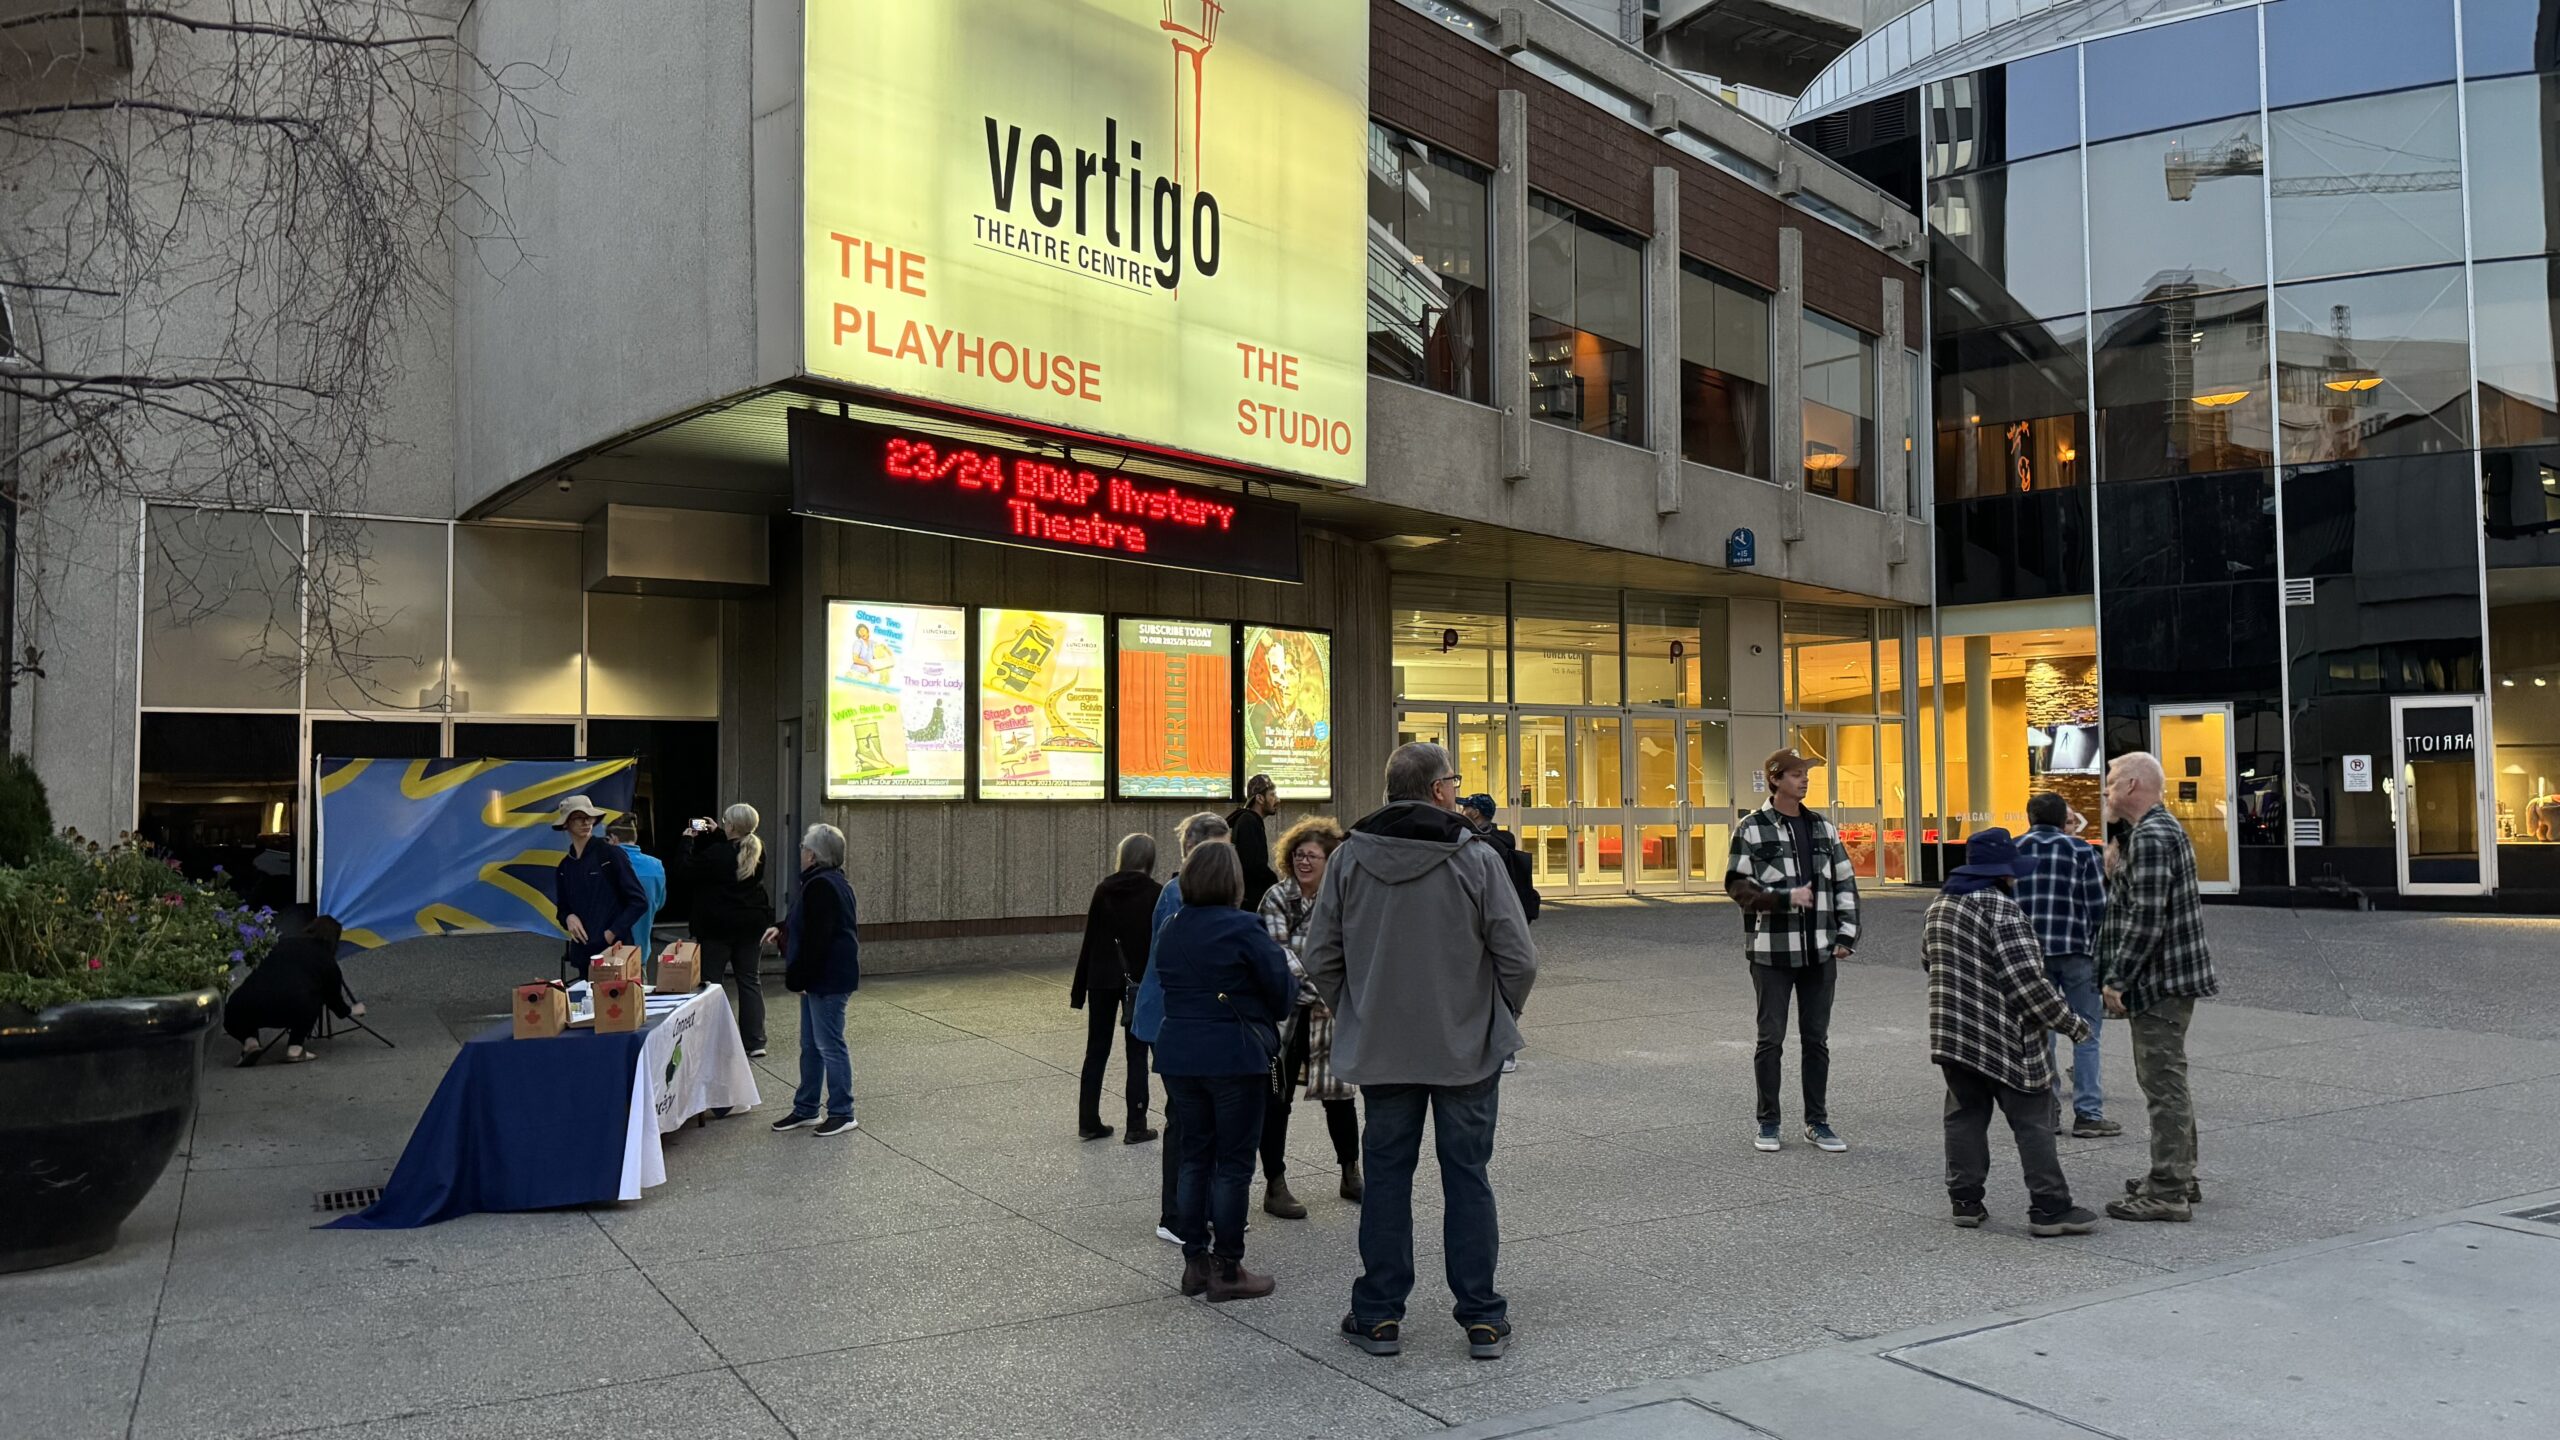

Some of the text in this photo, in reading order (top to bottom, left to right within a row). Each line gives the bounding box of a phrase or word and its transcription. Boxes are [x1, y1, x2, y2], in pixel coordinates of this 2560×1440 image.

[985, 116, 1220, 290] vertigo
[831, 231, 926, 297] THE
[974, 214, 1153, 288] THEATRE CENTRE
[833, 303, 1102, 402] PLAYHOUSE
[1237, 342, 1299, 391] THE
[1237, 398, 1352, 456] STUDIO
[886, 438, 1004, 491] 23/24
[1110, 477, 1235, 530] Mystery
[1008, 498, 1146, 553] Theatre
[856, 610, 902, 629] Stage Two
[874, 626, 903, 640] Festival
[1139, 624, 1212, 638] SUBSCRIBE TODAY
[1139, 636, 1148, 644] TO
[1149, 636, 1162, 645] OUR
[904, 676, 963, 690] The Dark Lady
[833, 708, 857, 721] With
[983, 704, 1034, 720] Stage One
[1164, 656, 1187, 770] VERTIGO
[673, 1009, 696, 1038] Connect
